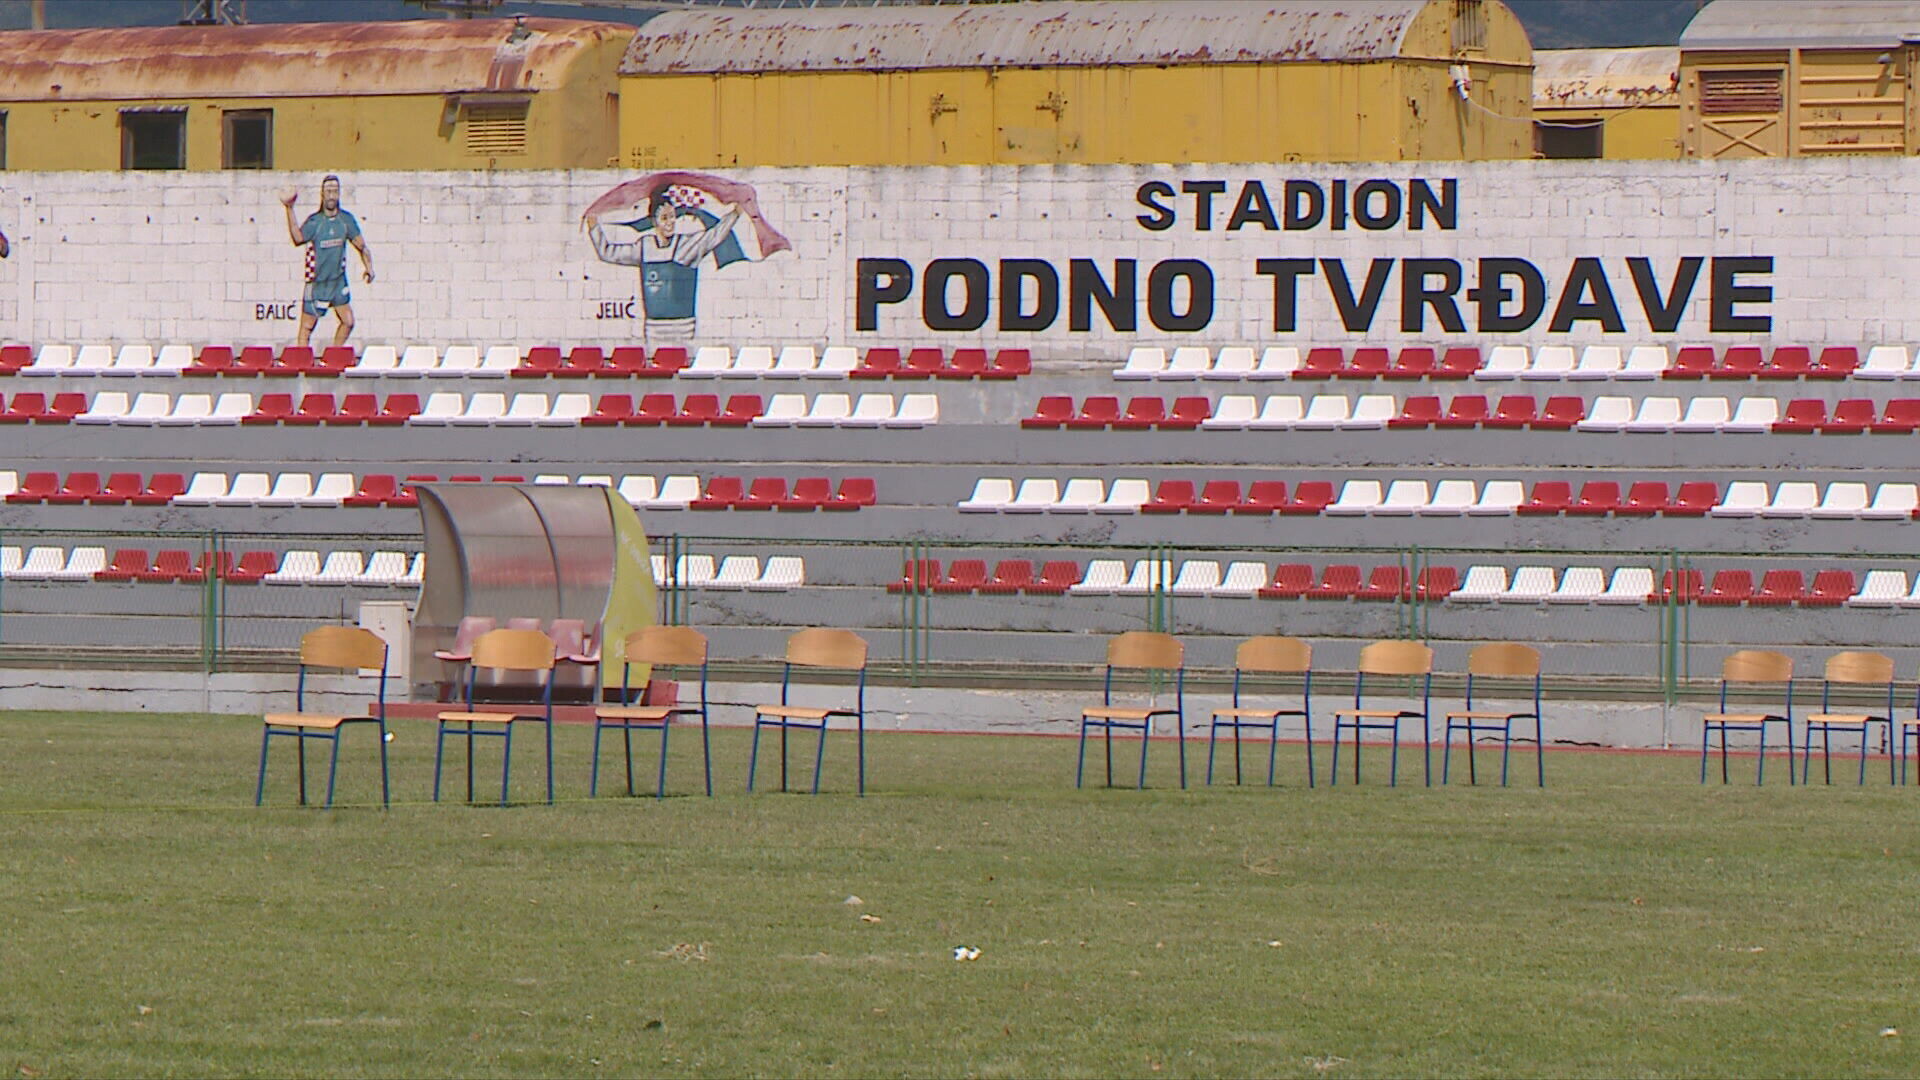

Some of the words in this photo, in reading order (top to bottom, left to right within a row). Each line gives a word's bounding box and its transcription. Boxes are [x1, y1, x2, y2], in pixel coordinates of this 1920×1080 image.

[1136, 178, 1457, 231] STADION
[255, 301, 297, 320] BALIĆ
[596, 296, 636, 320] JELIĆ
[855, 257, 1215, 332] PODNO
[1255, 256, 1774, 333] TVRĐAVE
